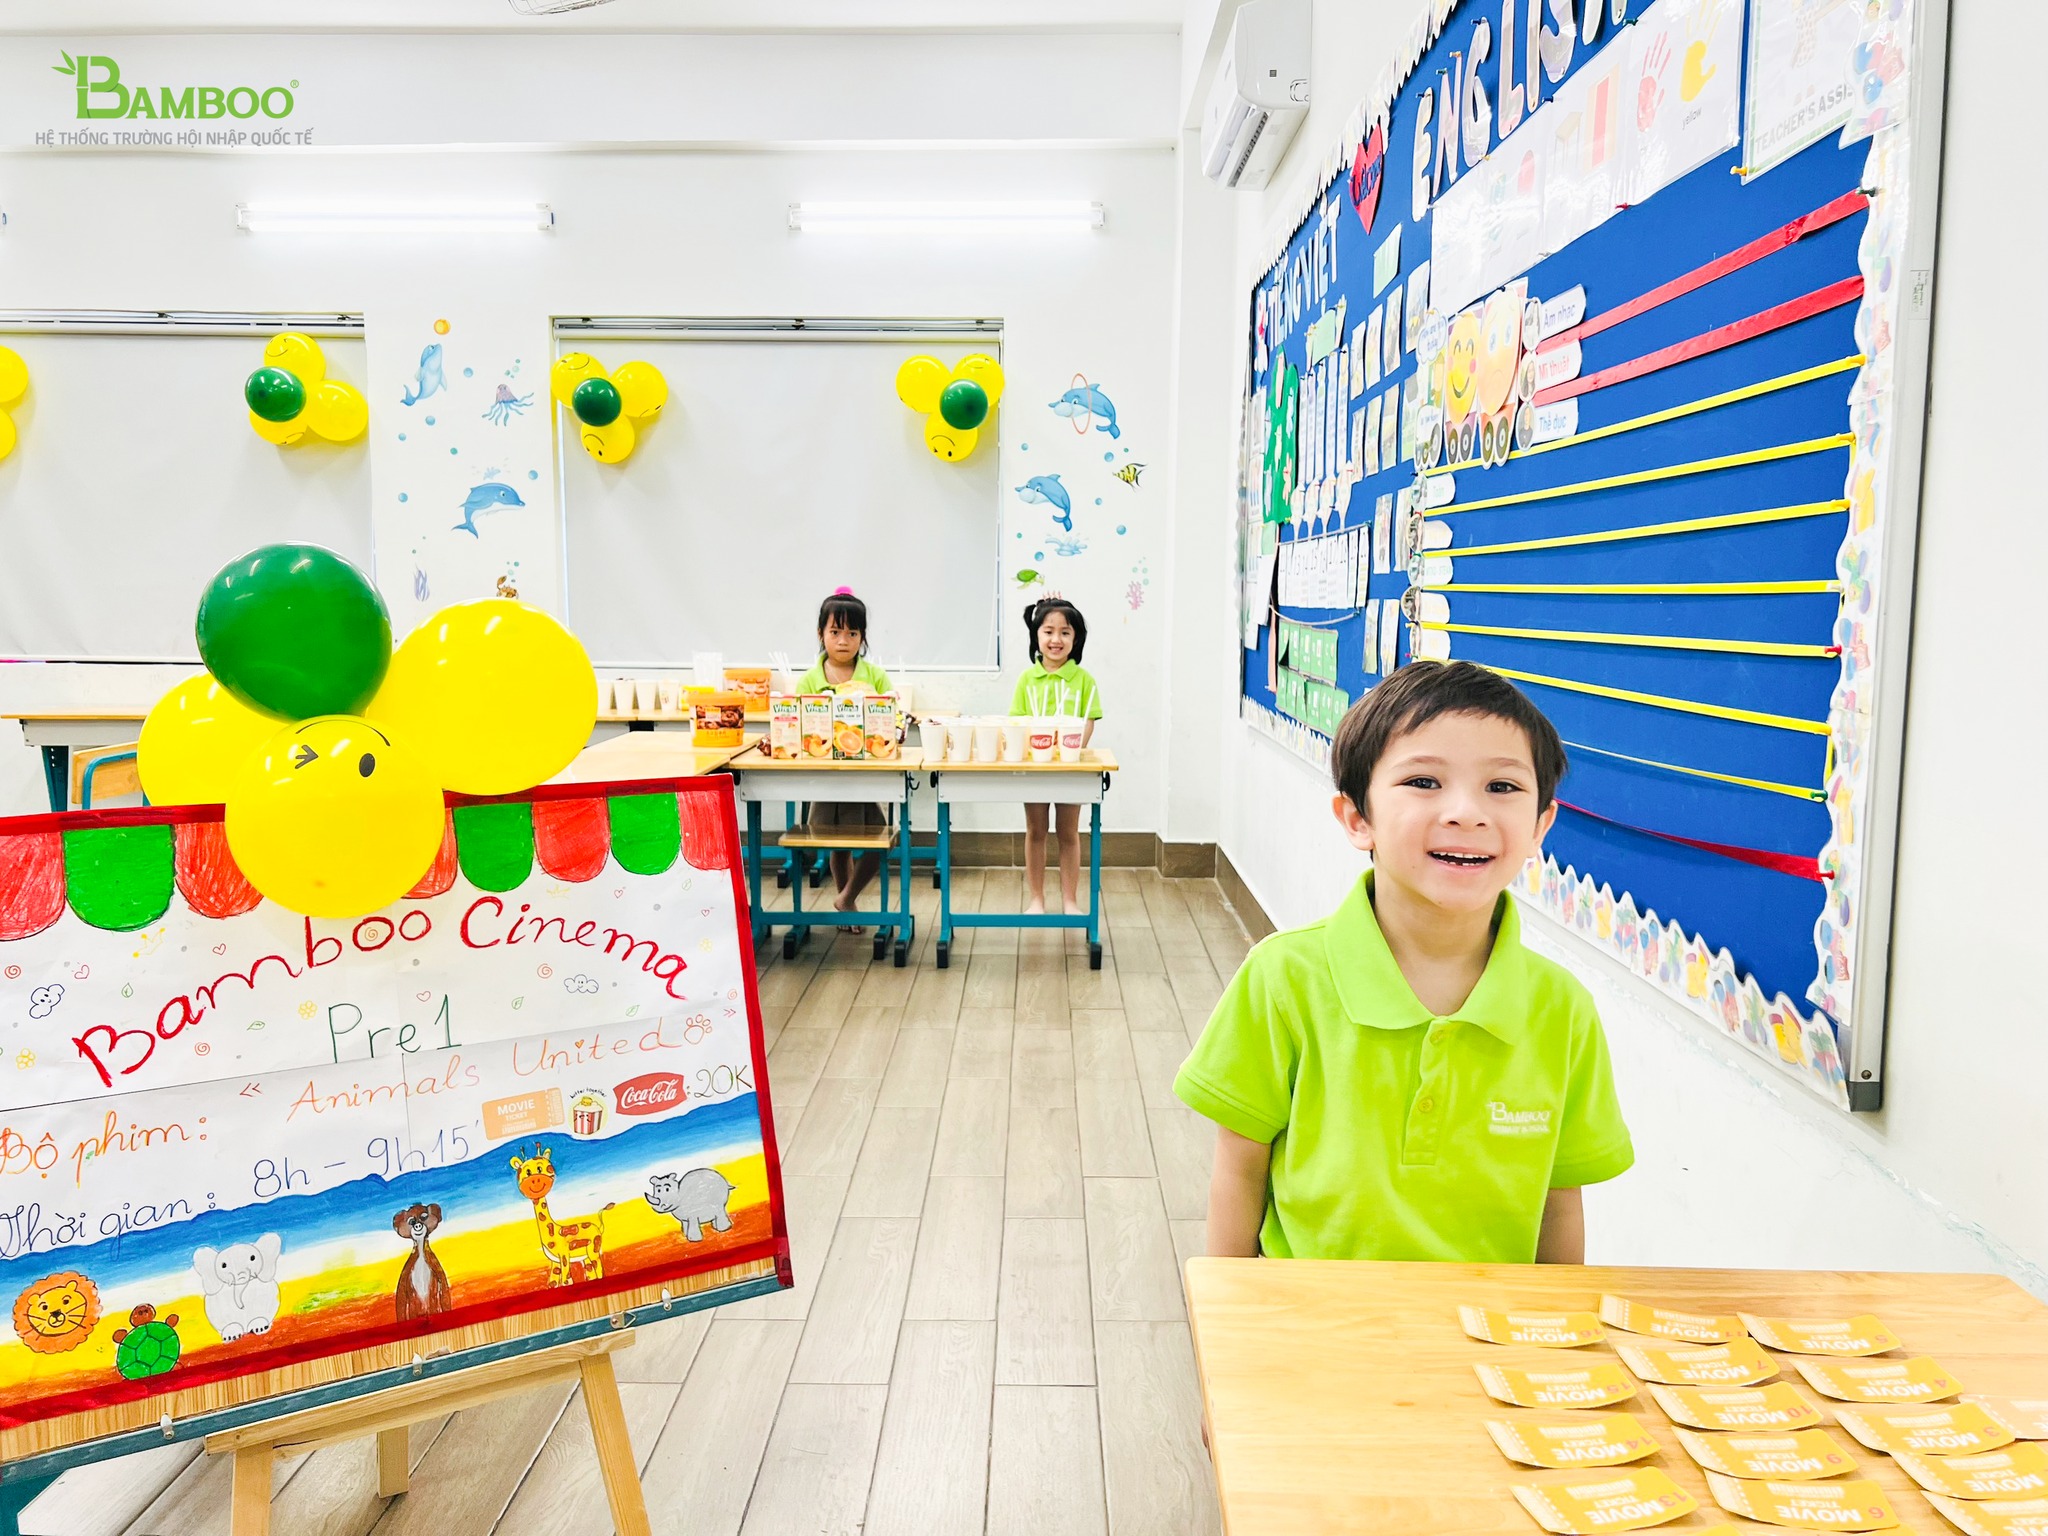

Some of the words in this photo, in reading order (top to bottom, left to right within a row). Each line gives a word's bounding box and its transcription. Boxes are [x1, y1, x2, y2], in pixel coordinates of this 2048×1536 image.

[1682, 106, 1702, 131] yellow
[1755, 104, 1816, 154] TEACHER'S
[72, 910, 432, 1088] Bamboo
[461, 895, 688, 1000] Cinema
[286, 1055, 480, 1124] Animals
[513, 1016, 683, 1076] United
[497, 1099, 535, 1116] MOVIE
[0, 1127, 59, 1179] Bộ
[0, 1202, 86, 1258] Thời
[1511, 1331, 1578, 1343] MOVIE
[1650, 1323, 1720, 1339] MOVIE
[1800, 1338, 1871, 1351] MOVIE
[1678, 1364, 1750, 1380] MOVIE
[1534, 1387, 1607, 1403] MOVIE
[1857, 1382, 1933, 1397] MOVIE
[1715, 1409, 1790, 1425] MOVIE
[1903, 1431, 1981, 1449] MOVIE
[1554, 1442, 1629, 1461] MOVIE
[1744, 1457, 1824, 1473] MOVIE
[1964, 1473, 2045, 1493] MOVIE
[1584, 1499, 1666, 1525] MOVIE
[1774, 1505, 1863, 1523] MOVIE
